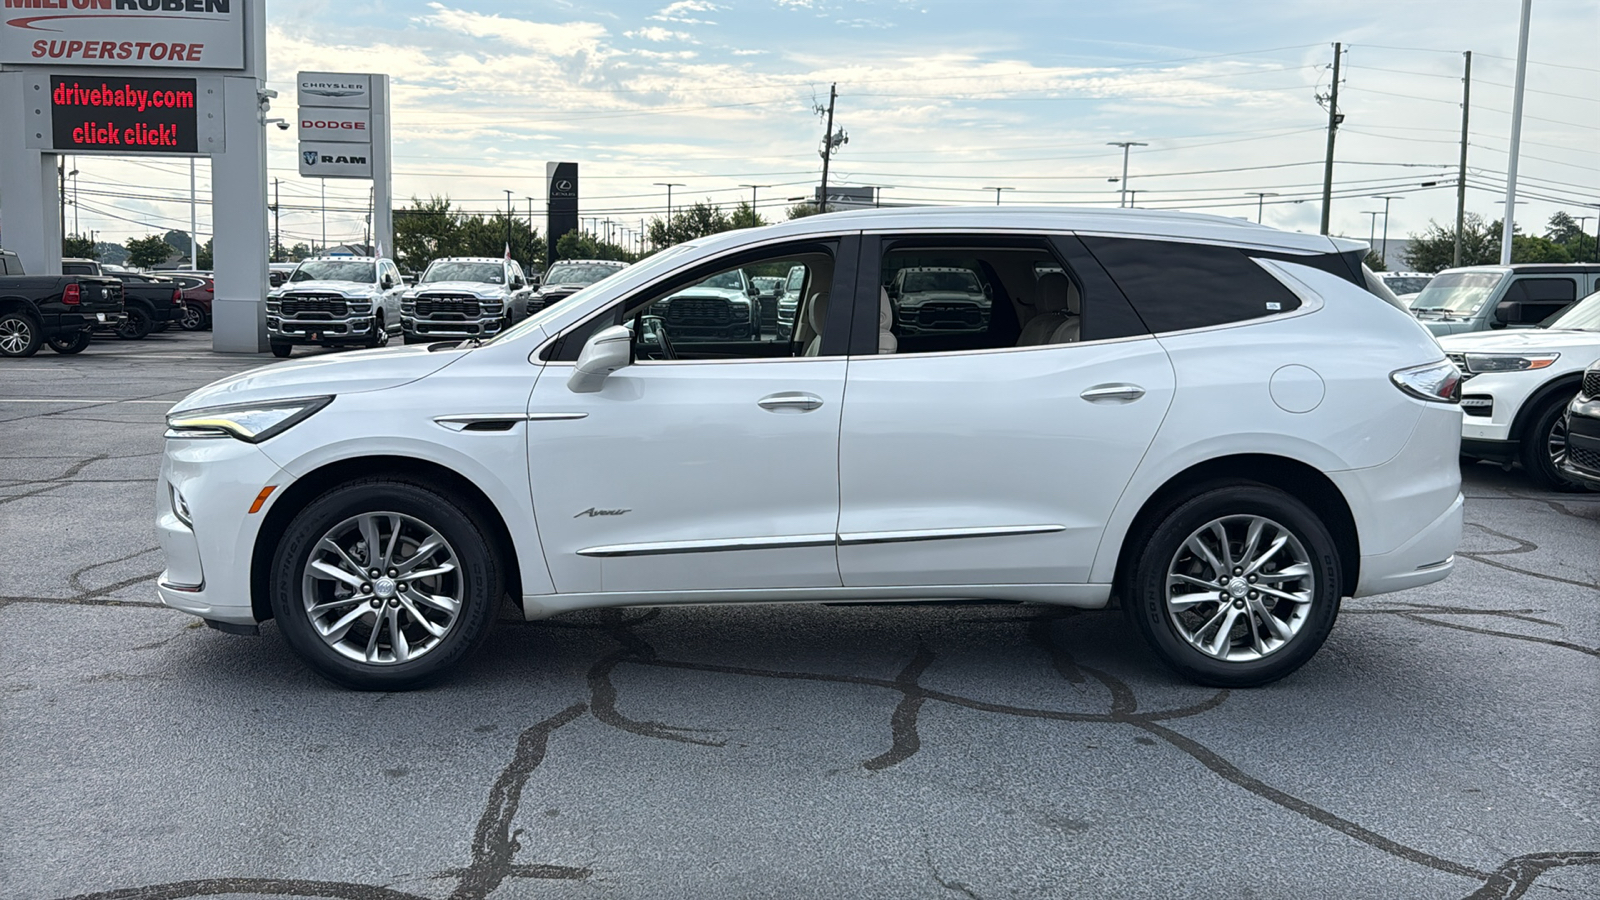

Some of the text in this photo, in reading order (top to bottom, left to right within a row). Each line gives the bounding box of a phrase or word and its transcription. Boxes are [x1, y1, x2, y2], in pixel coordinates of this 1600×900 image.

[115, 0, 230, 13] RUBEN
[31, 39, 204, 61] SUPERSTORE
[53, 82, 194, 112] drivebaby.com
[301, 120, 366, 130] DODGE
[72, 122, 177, 146] click click!
[321, 155, 366, 164] RAM
